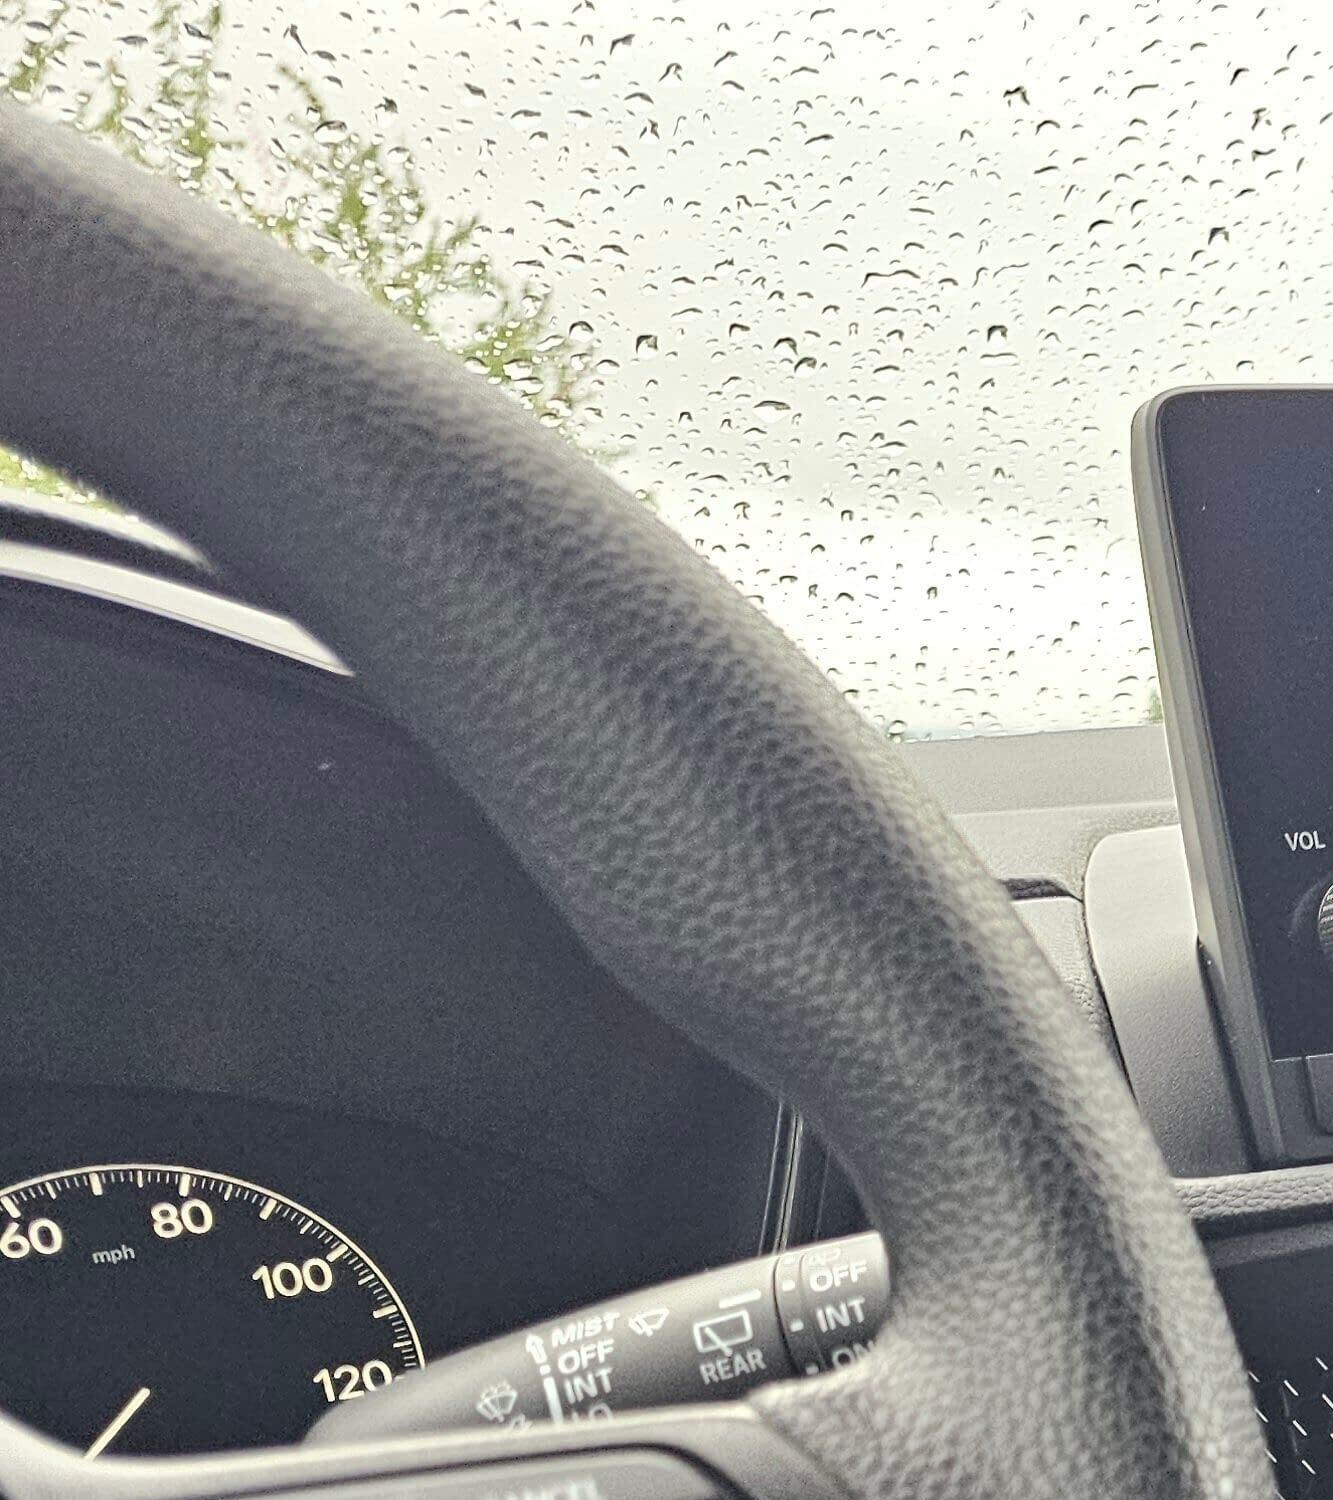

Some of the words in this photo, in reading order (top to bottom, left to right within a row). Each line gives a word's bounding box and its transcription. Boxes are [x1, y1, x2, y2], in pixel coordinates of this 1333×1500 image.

[1284, 830, 1326, 851] VOL
[150, 1199, 214, 1239] 80
[0, 1217, 63, 1259] 60
[92, 1244, 136, 1265] mph
[252, 1257, 333, 1299] 100
[810, 1259, 867, 1292] OFF
[550, 1311, 621, 1348] MIST
[816, 1295, 866, 1333] INT
[557, 1339, 614, 1374] OFF
[701, 1348, 767, 1385] REAR
[312, 1359, 393, 1402] 120
[564, 1366, 613, 1404] INT
